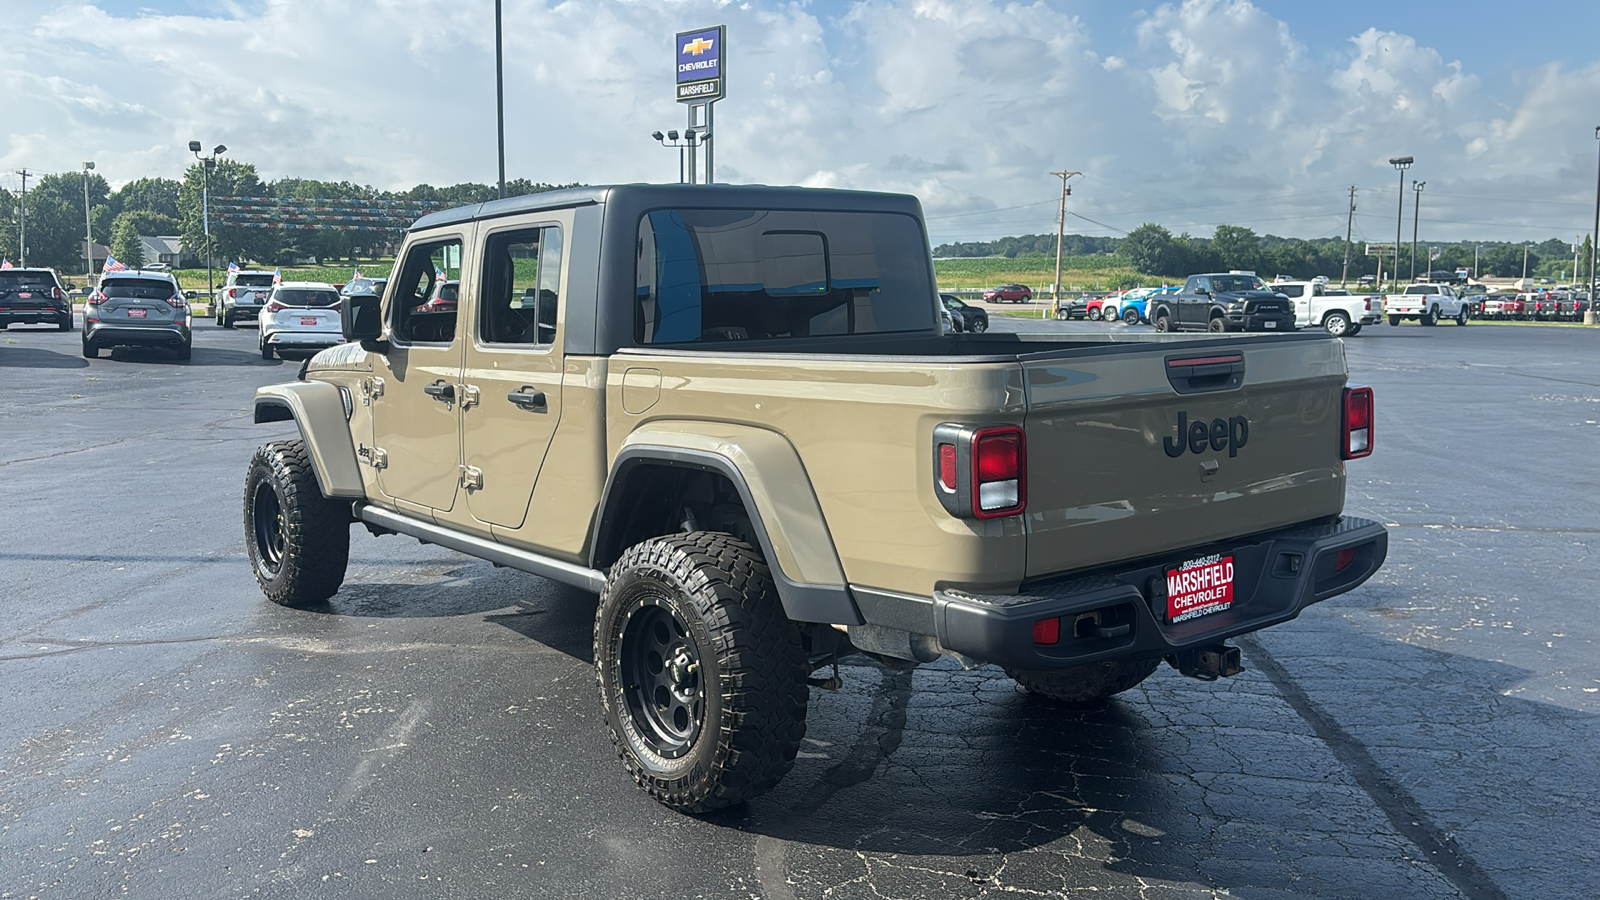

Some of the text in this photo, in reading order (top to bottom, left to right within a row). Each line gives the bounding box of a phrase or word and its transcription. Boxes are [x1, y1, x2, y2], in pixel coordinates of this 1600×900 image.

[678, 59, 717, 72] CHEVROLET
[680, 83, 714, 95] MARSHFIELD
[1163, 411, 1248, 458] Jeep
[1167, 563, 1233, 596] MARSHFIELD
[1174, 586, 1227, 608] CHEVROLET
[1173, 609, 1202, 623] MARSHFIELD
[1203, 602, 1230, 615] CHEVROLET
